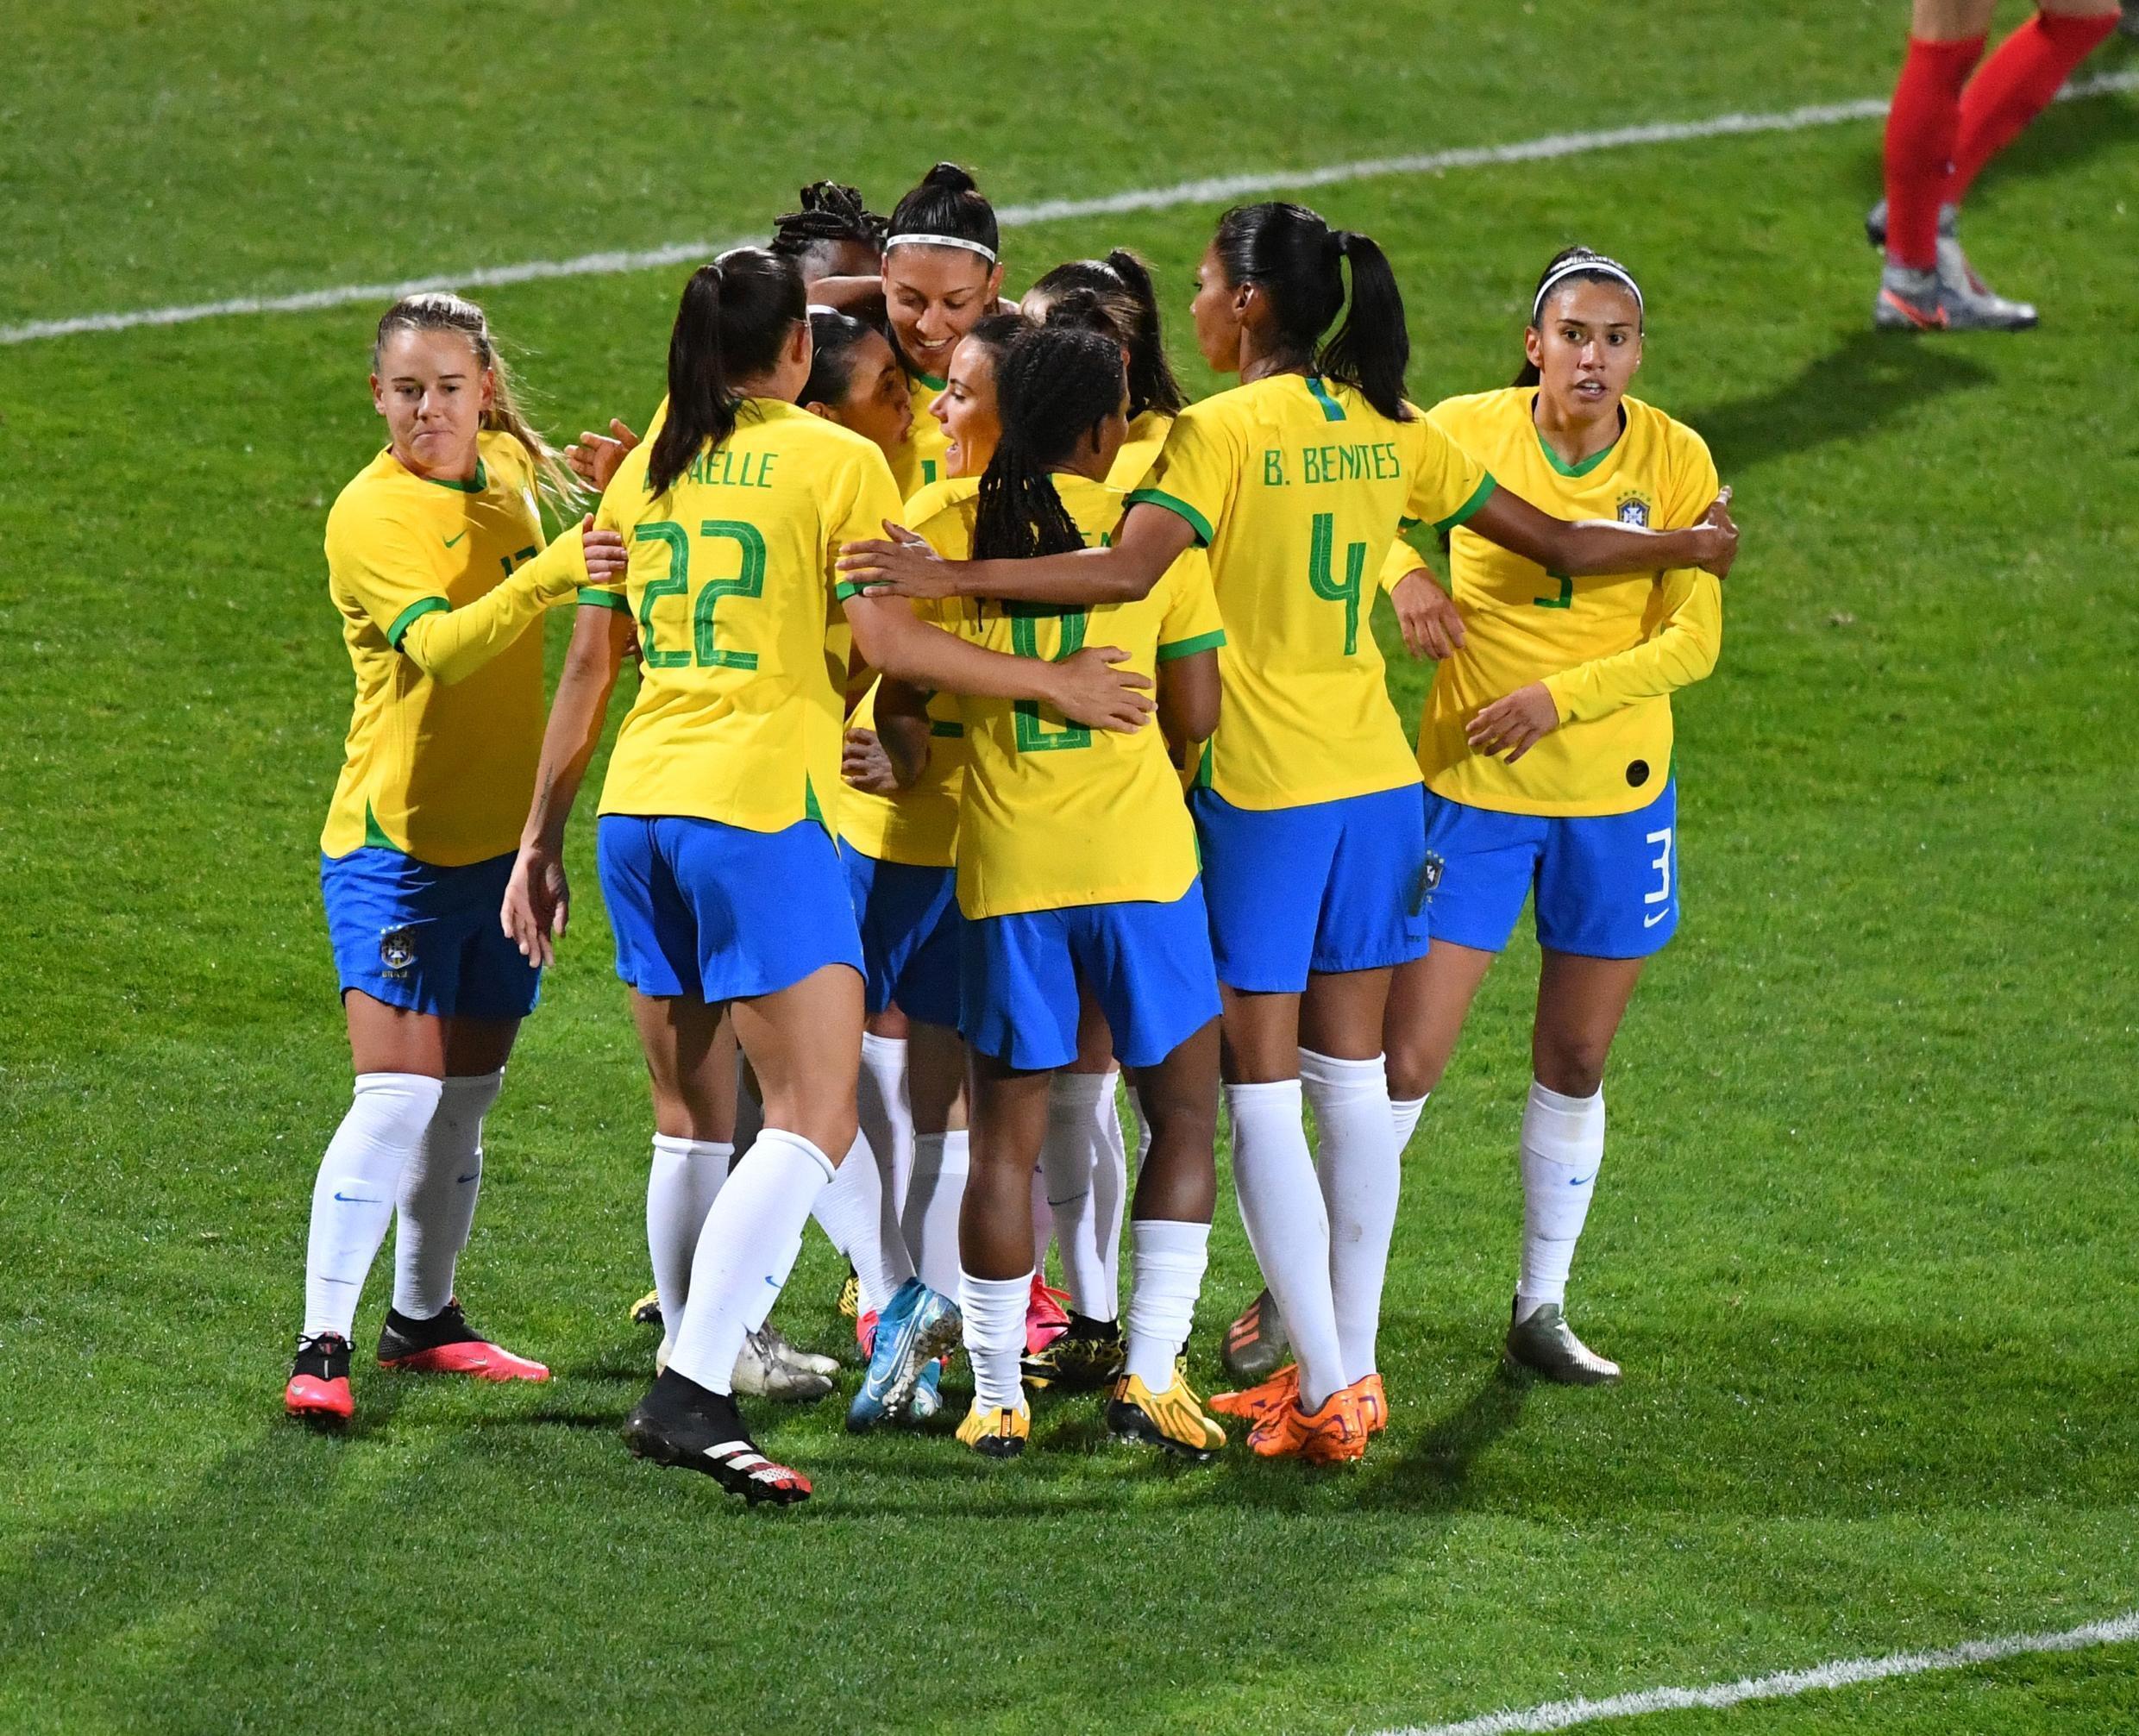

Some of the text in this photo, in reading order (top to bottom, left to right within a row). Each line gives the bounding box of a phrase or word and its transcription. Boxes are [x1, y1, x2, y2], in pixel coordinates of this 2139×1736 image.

[643, 450, 779, 492] AELLE
[1264, 442, 1401, 486] B. BENITES
[634, 519, 767, 670] 22
[1308, 512, 1367, 656] 4
[1644, 827, 1672, 904] 3
